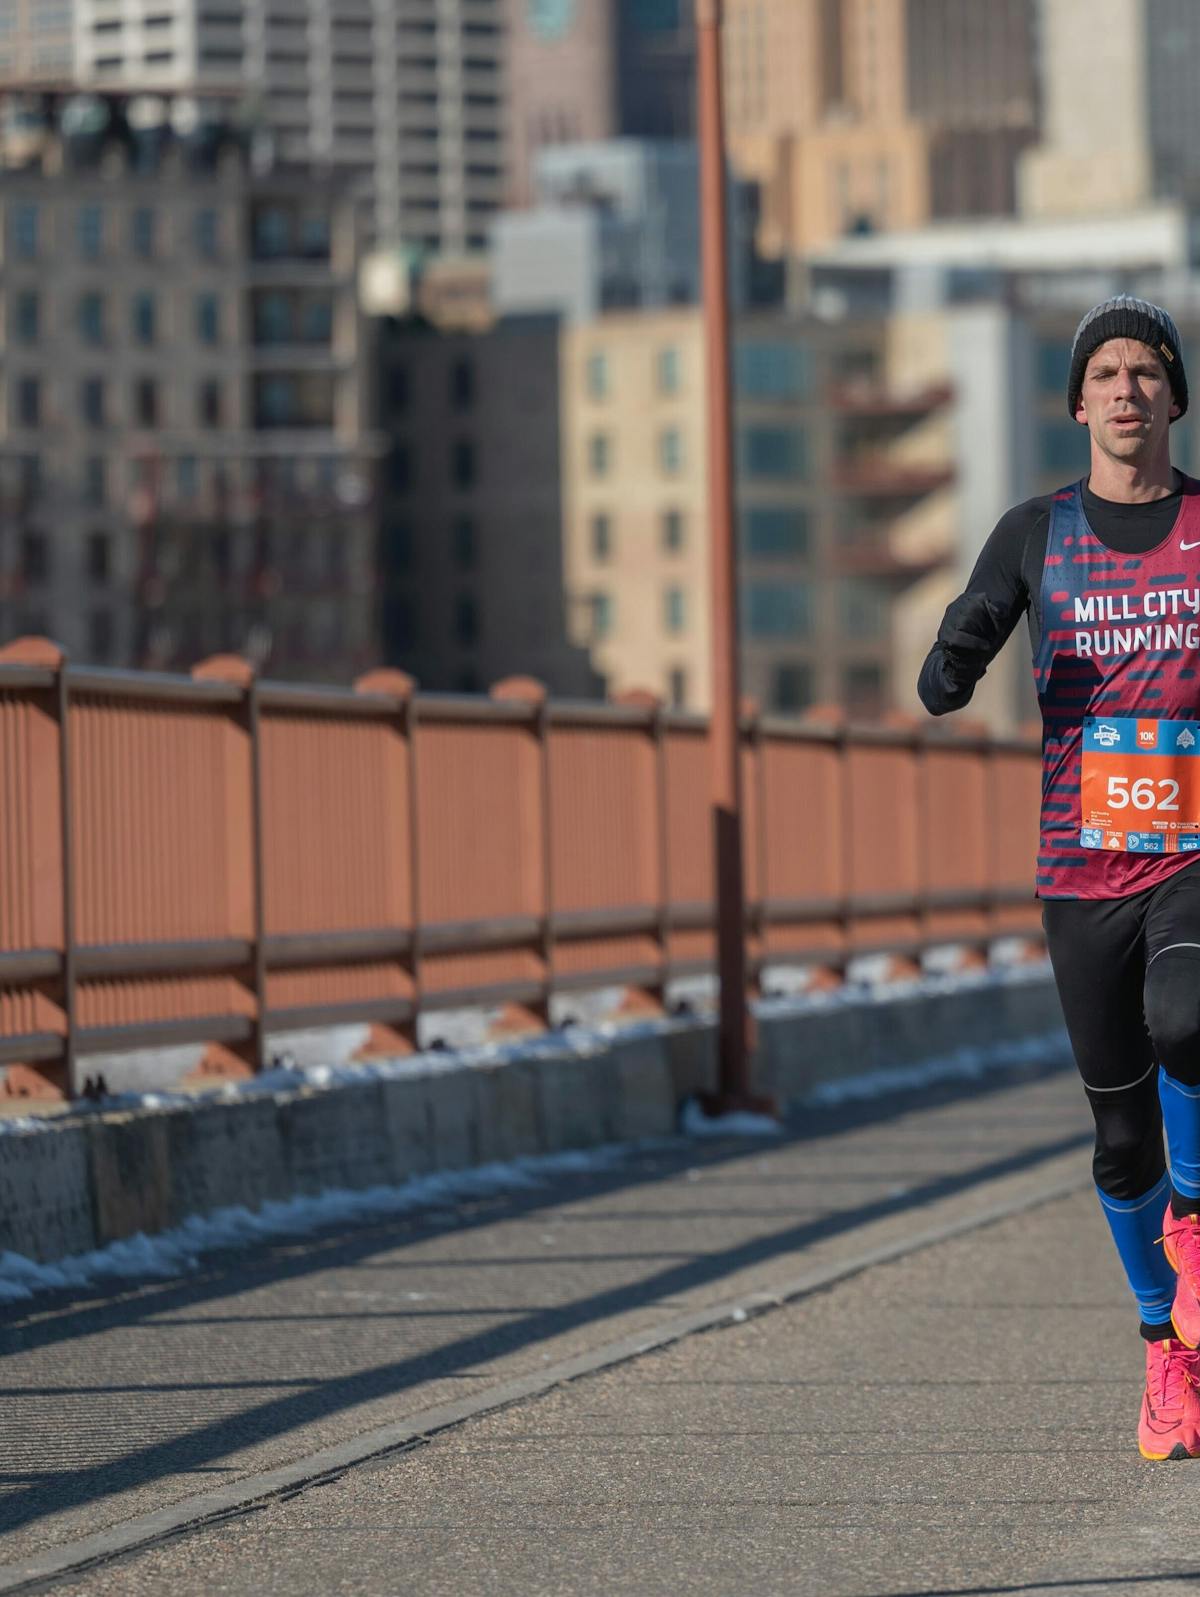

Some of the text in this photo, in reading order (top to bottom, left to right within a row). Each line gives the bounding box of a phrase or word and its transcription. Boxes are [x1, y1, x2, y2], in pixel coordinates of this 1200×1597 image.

[1074, 588, 1200, 622] MILL CITY
[1075, 623, 1200, 658] RUNNING
[1139, 732, 1154, 741] 10K
[1106, 777, 1180, 810] 562
[1144, 842, 1158, 850] 562
